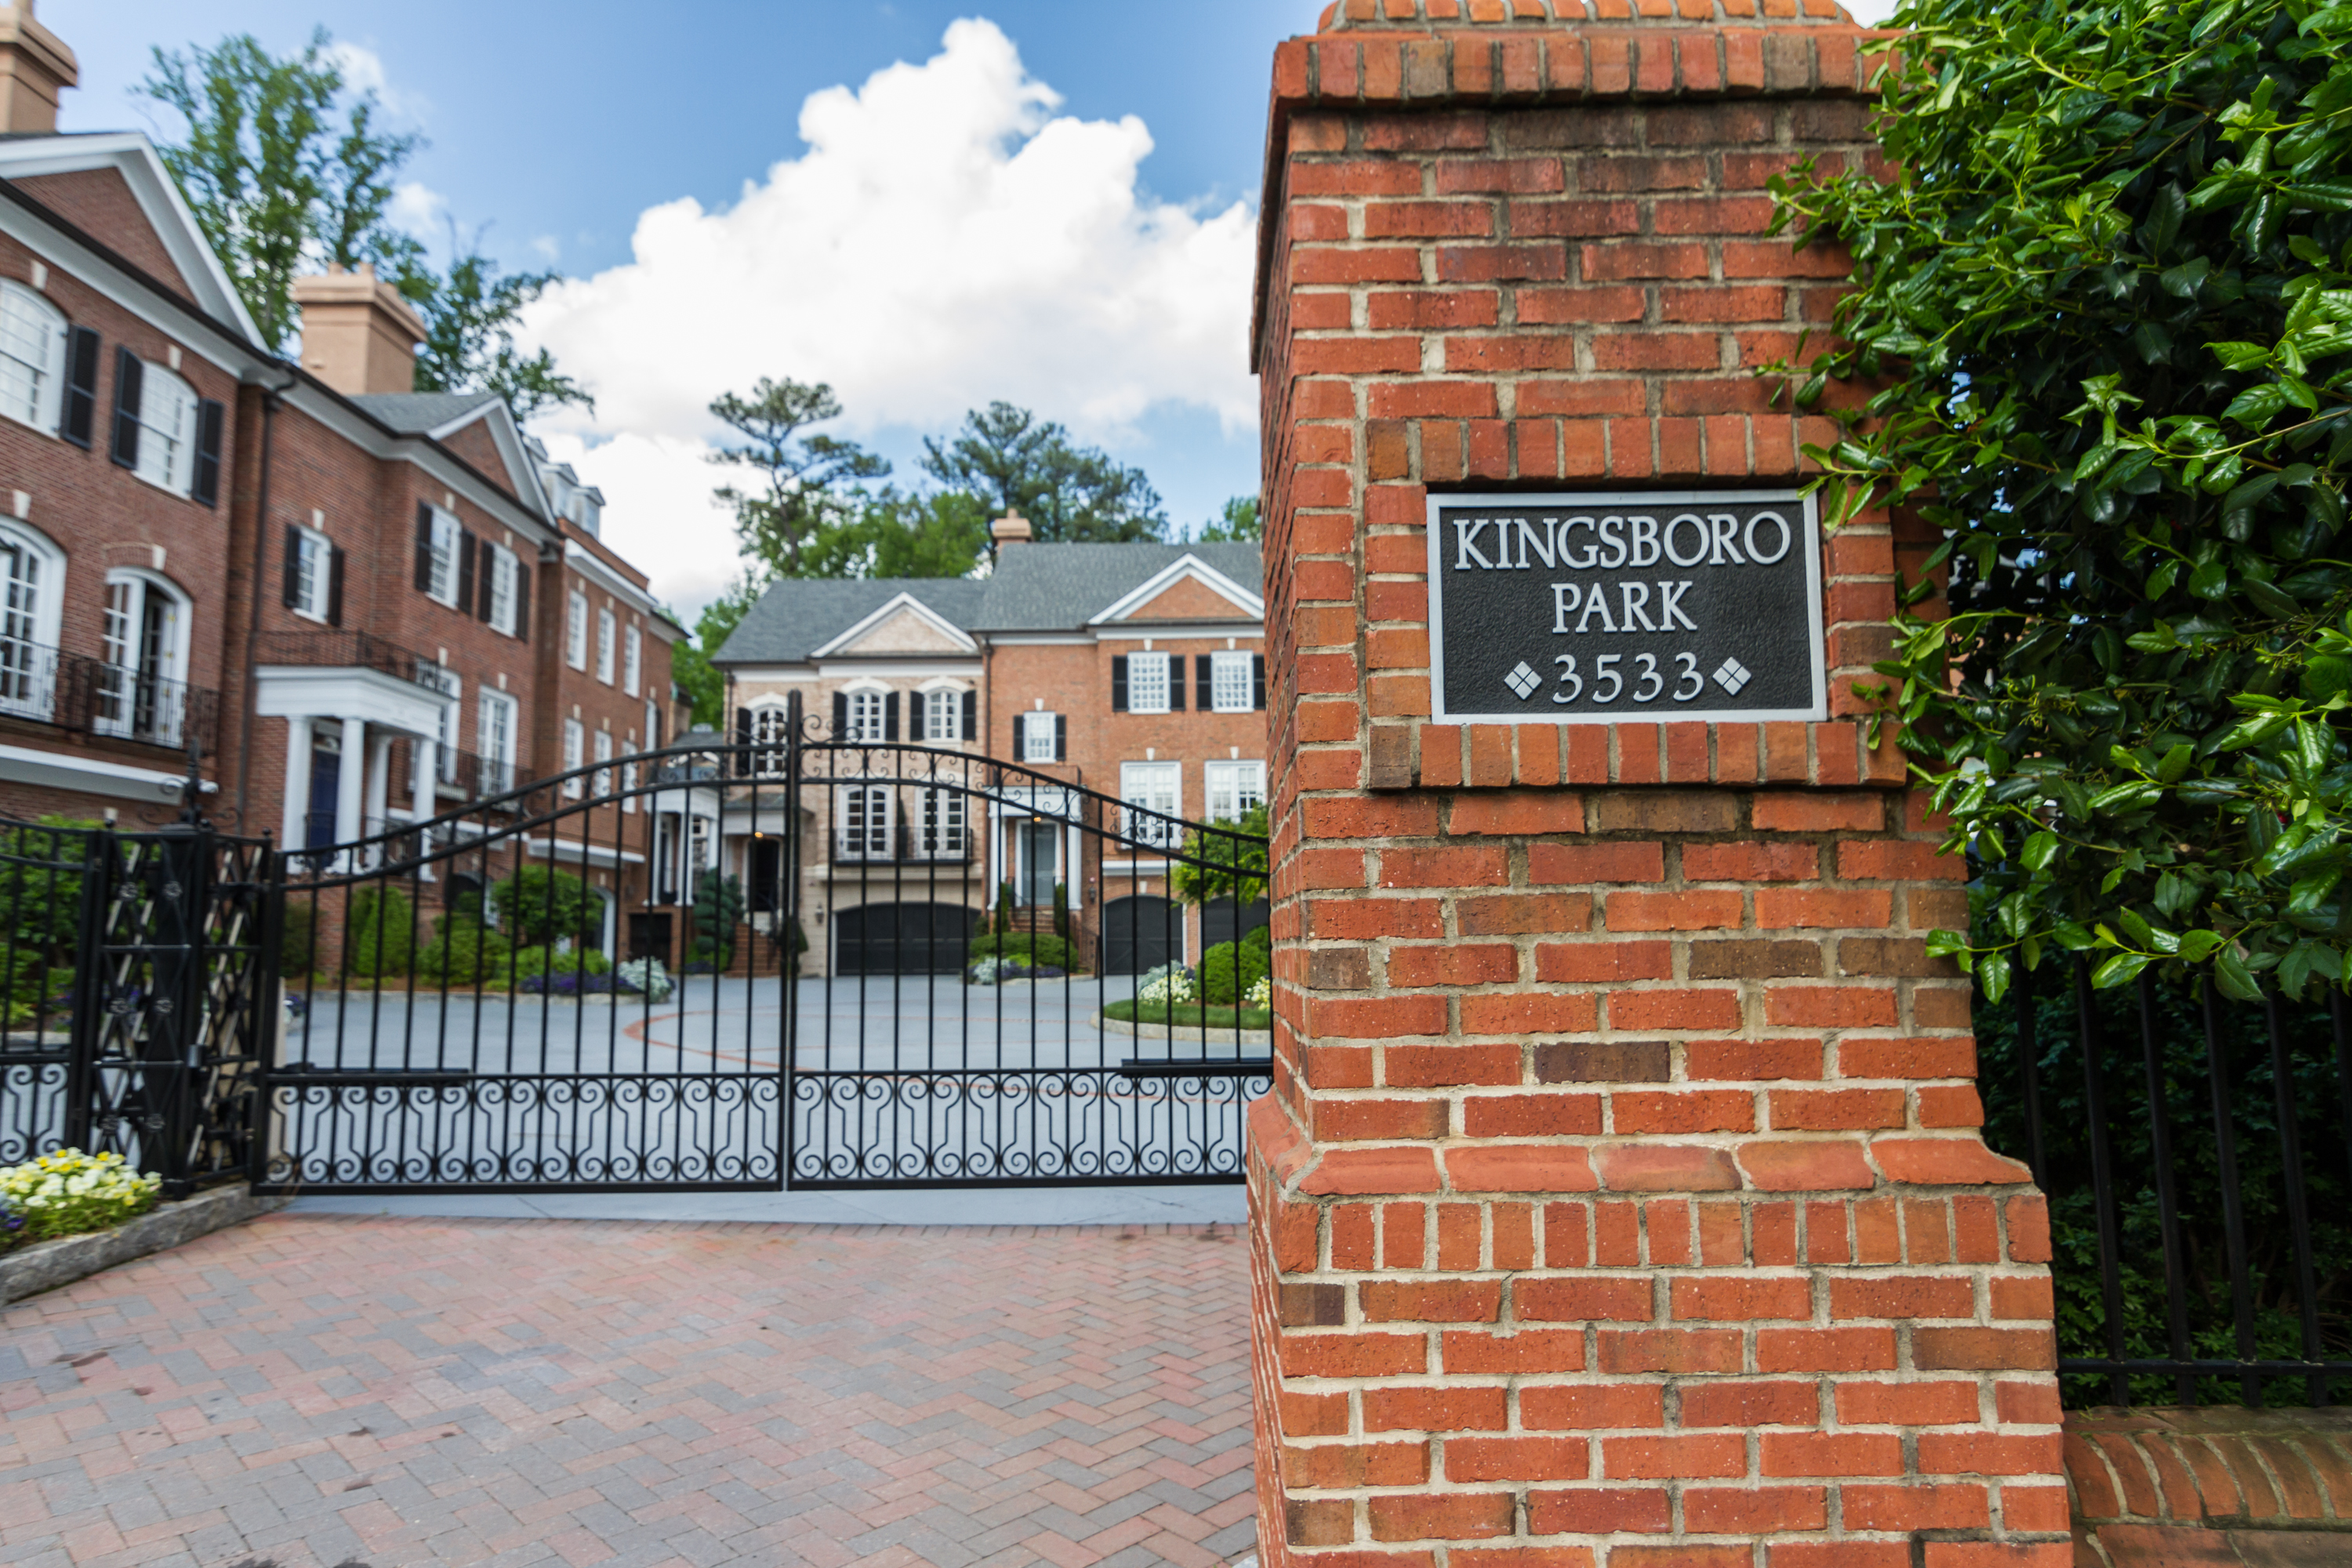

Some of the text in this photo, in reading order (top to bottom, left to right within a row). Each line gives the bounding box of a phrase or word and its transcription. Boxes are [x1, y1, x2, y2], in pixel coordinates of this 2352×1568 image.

[1453, 511, 1791, 569] KINGSBORO
[1551, 580, 1697, 633] PARK
[1552, 652, 1704, 703] 3533
